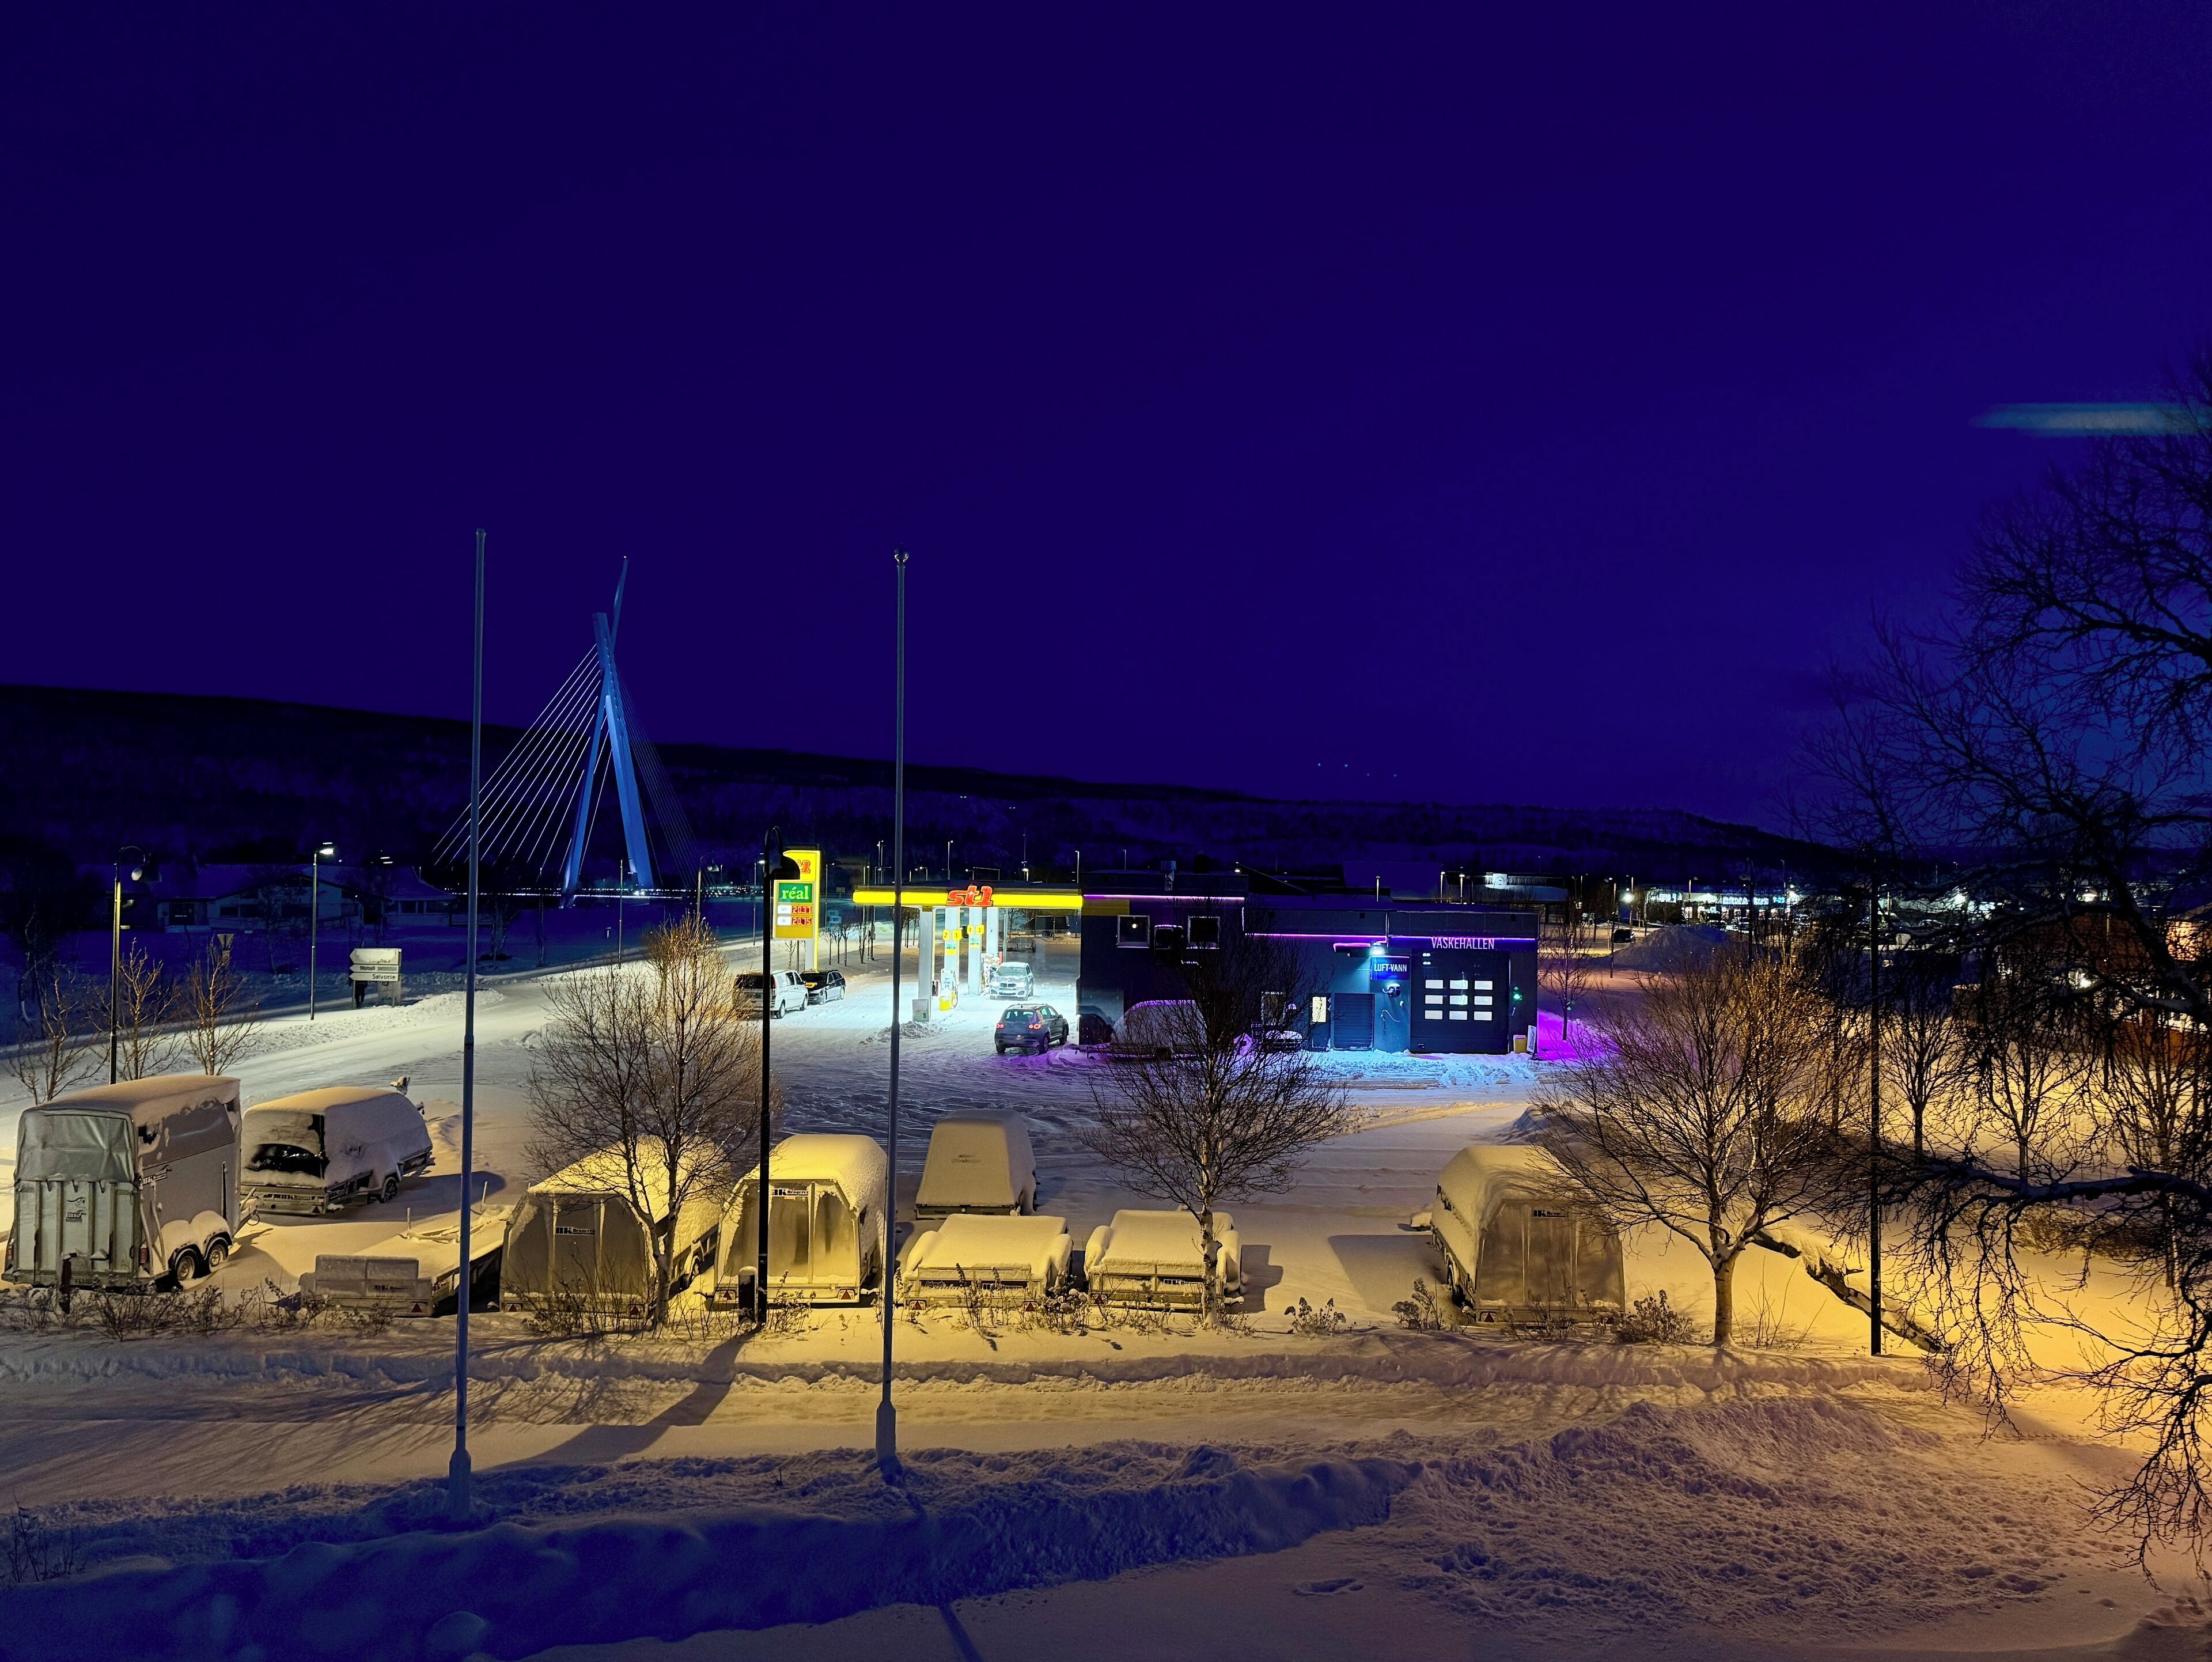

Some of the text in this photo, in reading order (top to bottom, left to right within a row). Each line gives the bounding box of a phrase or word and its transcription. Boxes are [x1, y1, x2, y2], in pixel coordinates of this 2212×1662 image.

[782, 885, 809, 900] réal
[1431, 937, 1495, 950] VASKEHALLEN
[1374, 963, 1407, 972] LUFT-VANN
